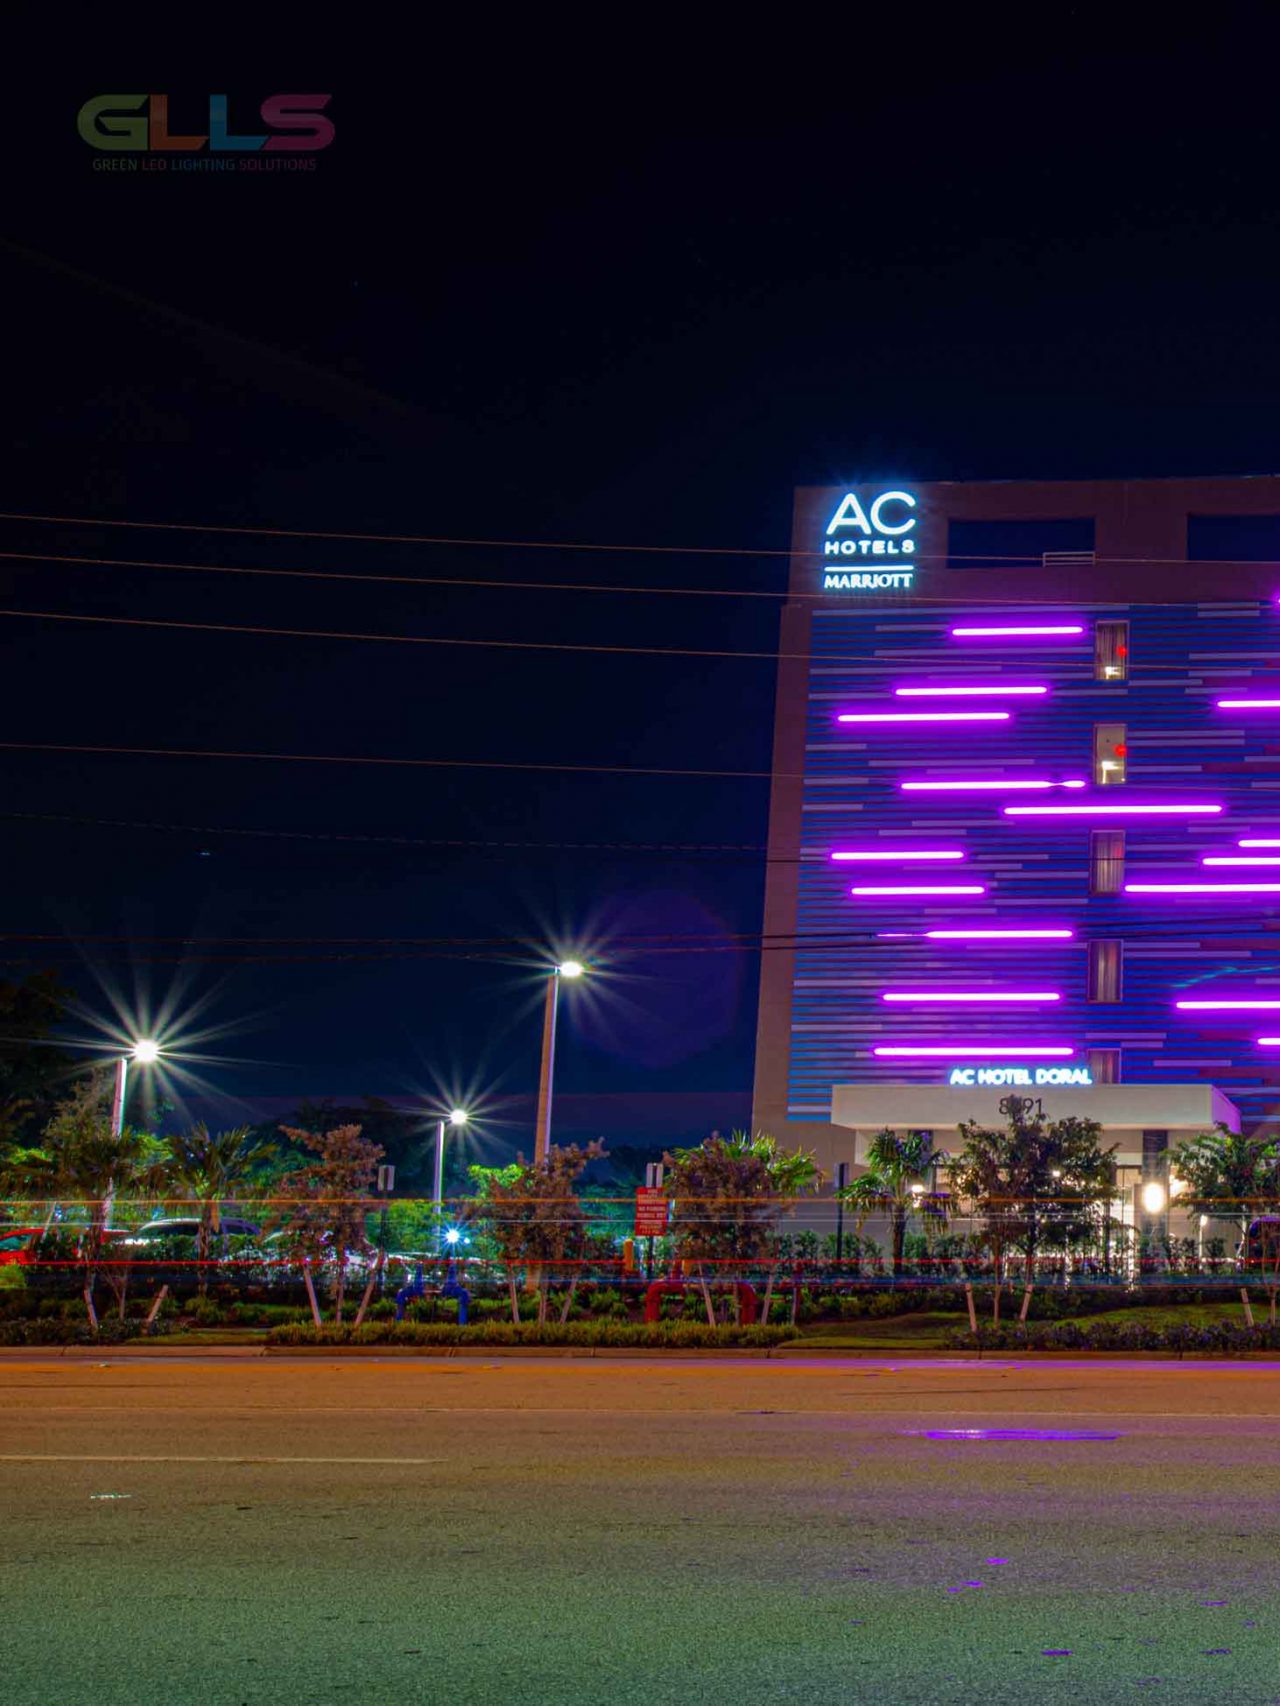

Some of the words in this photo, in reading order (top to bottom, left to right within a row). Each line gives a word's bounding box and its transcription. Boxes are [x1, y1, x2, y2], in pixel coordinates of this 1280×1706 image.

[826, 491, 916, 535] AC
[824, 539, 915, 555] HOTELS
[824, 573, 914, 590] MARRIOTT
[950, 1068, 975, 1085] AC
[978, 1068, 1033, 1085] HOTEL
[1036, 1068, 1093, 1085] DORAL
[998, 1098, 1042, 1115] 891
